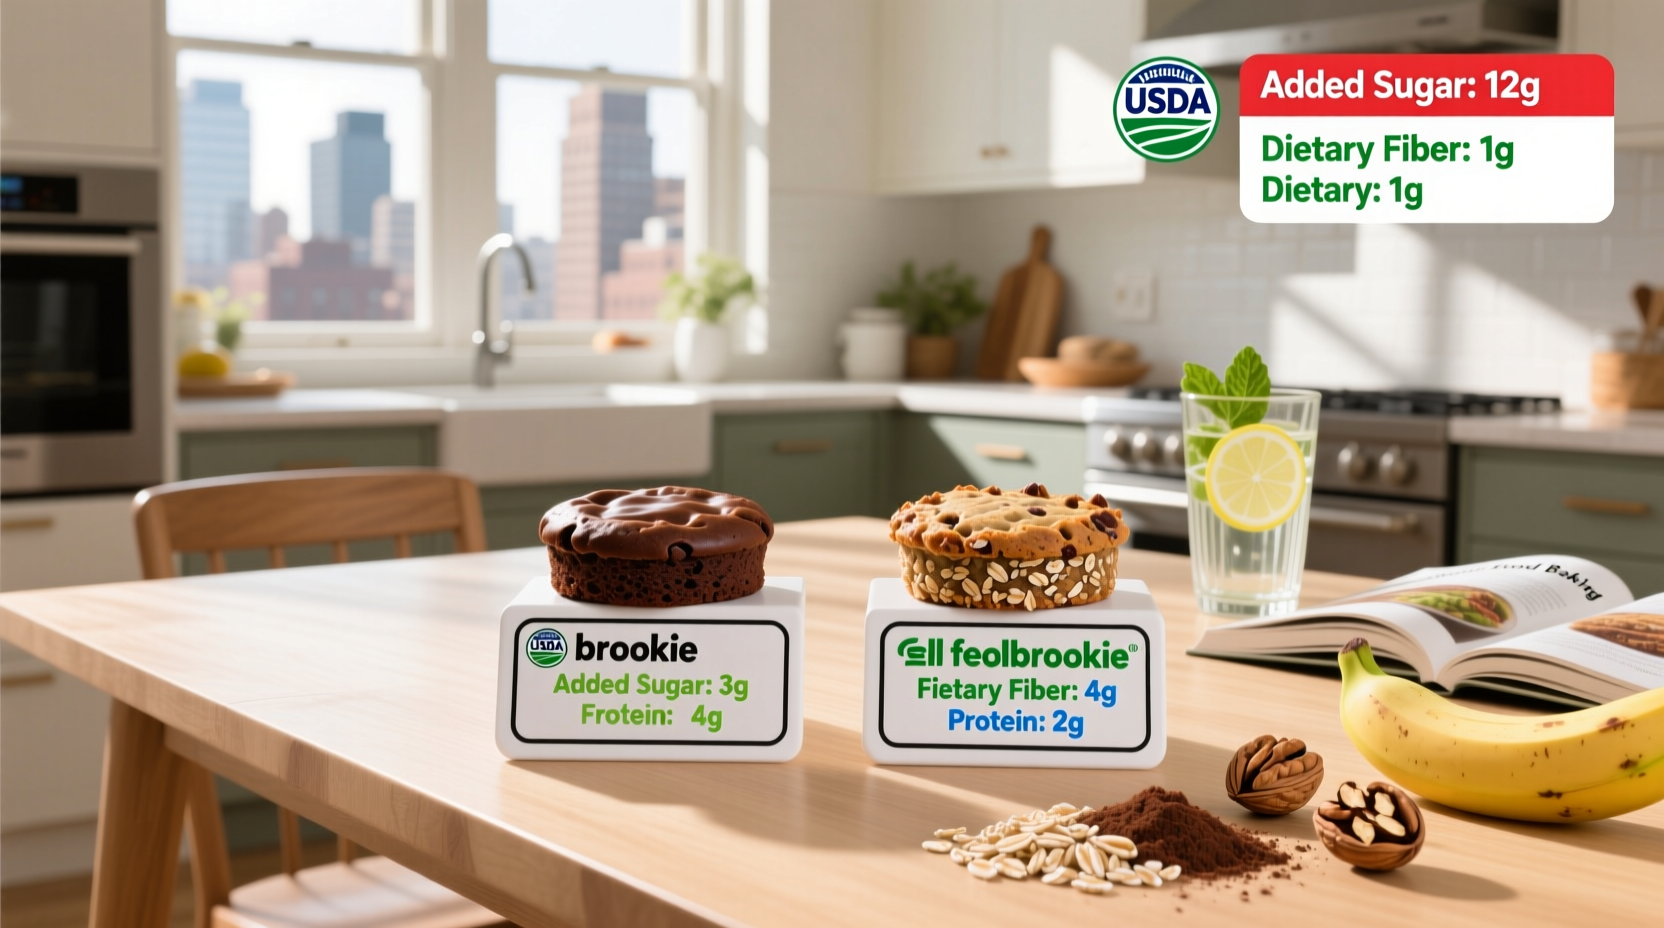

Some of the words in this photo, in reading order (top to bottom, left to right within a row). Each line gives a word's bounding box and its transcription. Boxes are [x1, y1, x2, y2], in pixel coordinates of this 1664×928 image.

[575, 633, 698, 663] brookie
[553, 673, 629, 694] Added
[636, 674, 712, 701] Sugar:
[719, 674, 748, 702] 3g
[918, 677, 1002, 706] Fietary
[1009, 678, 1078, 701] Fiber:
[1084, 679, 1117, 707] 4g
[581, 704, 673, 725] Frotein:
[691, 705, 723, 732] 4g
[948, 709, 1045, 732] Protein:
[1052, 710, 1084, 739] 2g
